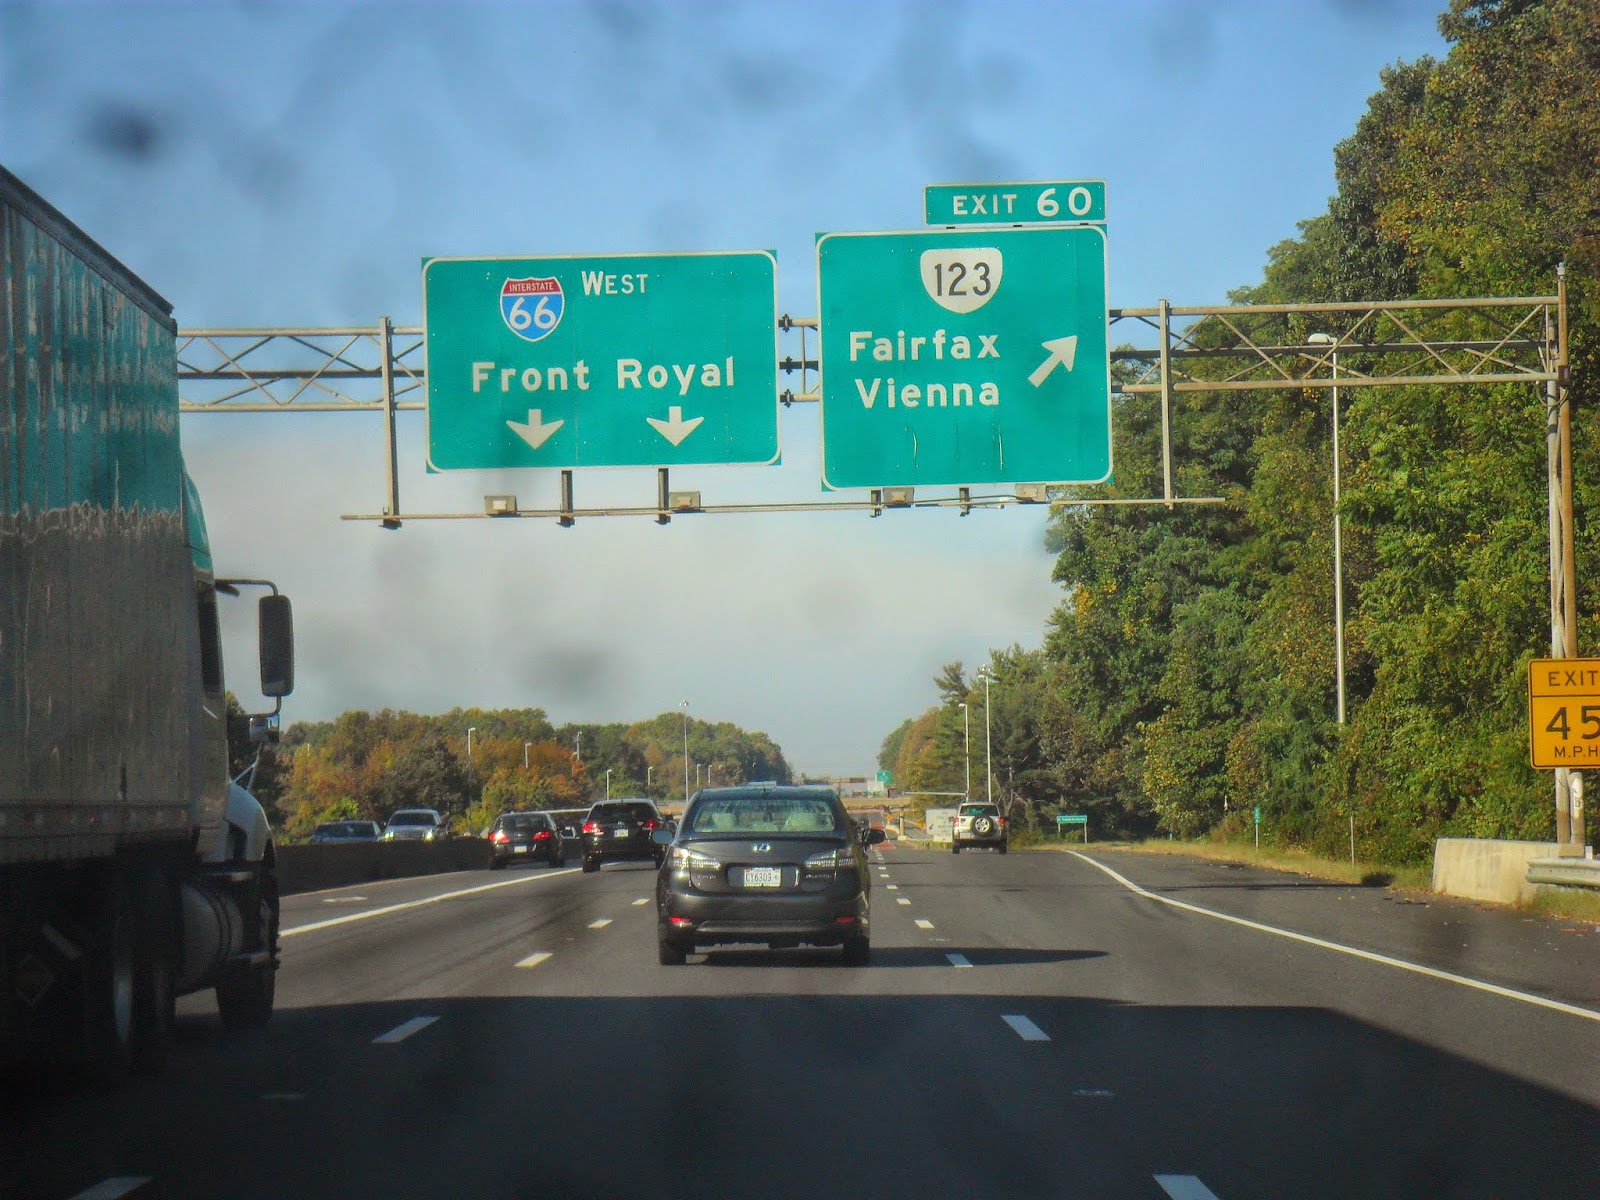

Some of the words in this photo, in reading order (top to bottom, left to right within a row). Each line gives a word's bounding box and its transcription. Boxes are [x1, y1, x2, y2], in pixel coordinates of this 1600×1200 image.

[952, 194, 1017, 215] EXIT
[1037, 187, 1092, 217] 60
[509, 282, 554, 292] INTERSTATE
[581, 270, 648, 296] WEST
[934, 262, 991, 296] 123
[509, 296, 556, 330] 66
[849, 329, 1001, 361] Fairfax
[472, 360, 590, 392] Front
[617, 356, 734, 396] Royal
[855, 377, 999, 408] Vienna
[1548, 671, 1598, 686] EXIT
[1545, 705, 1600, 740] 45
